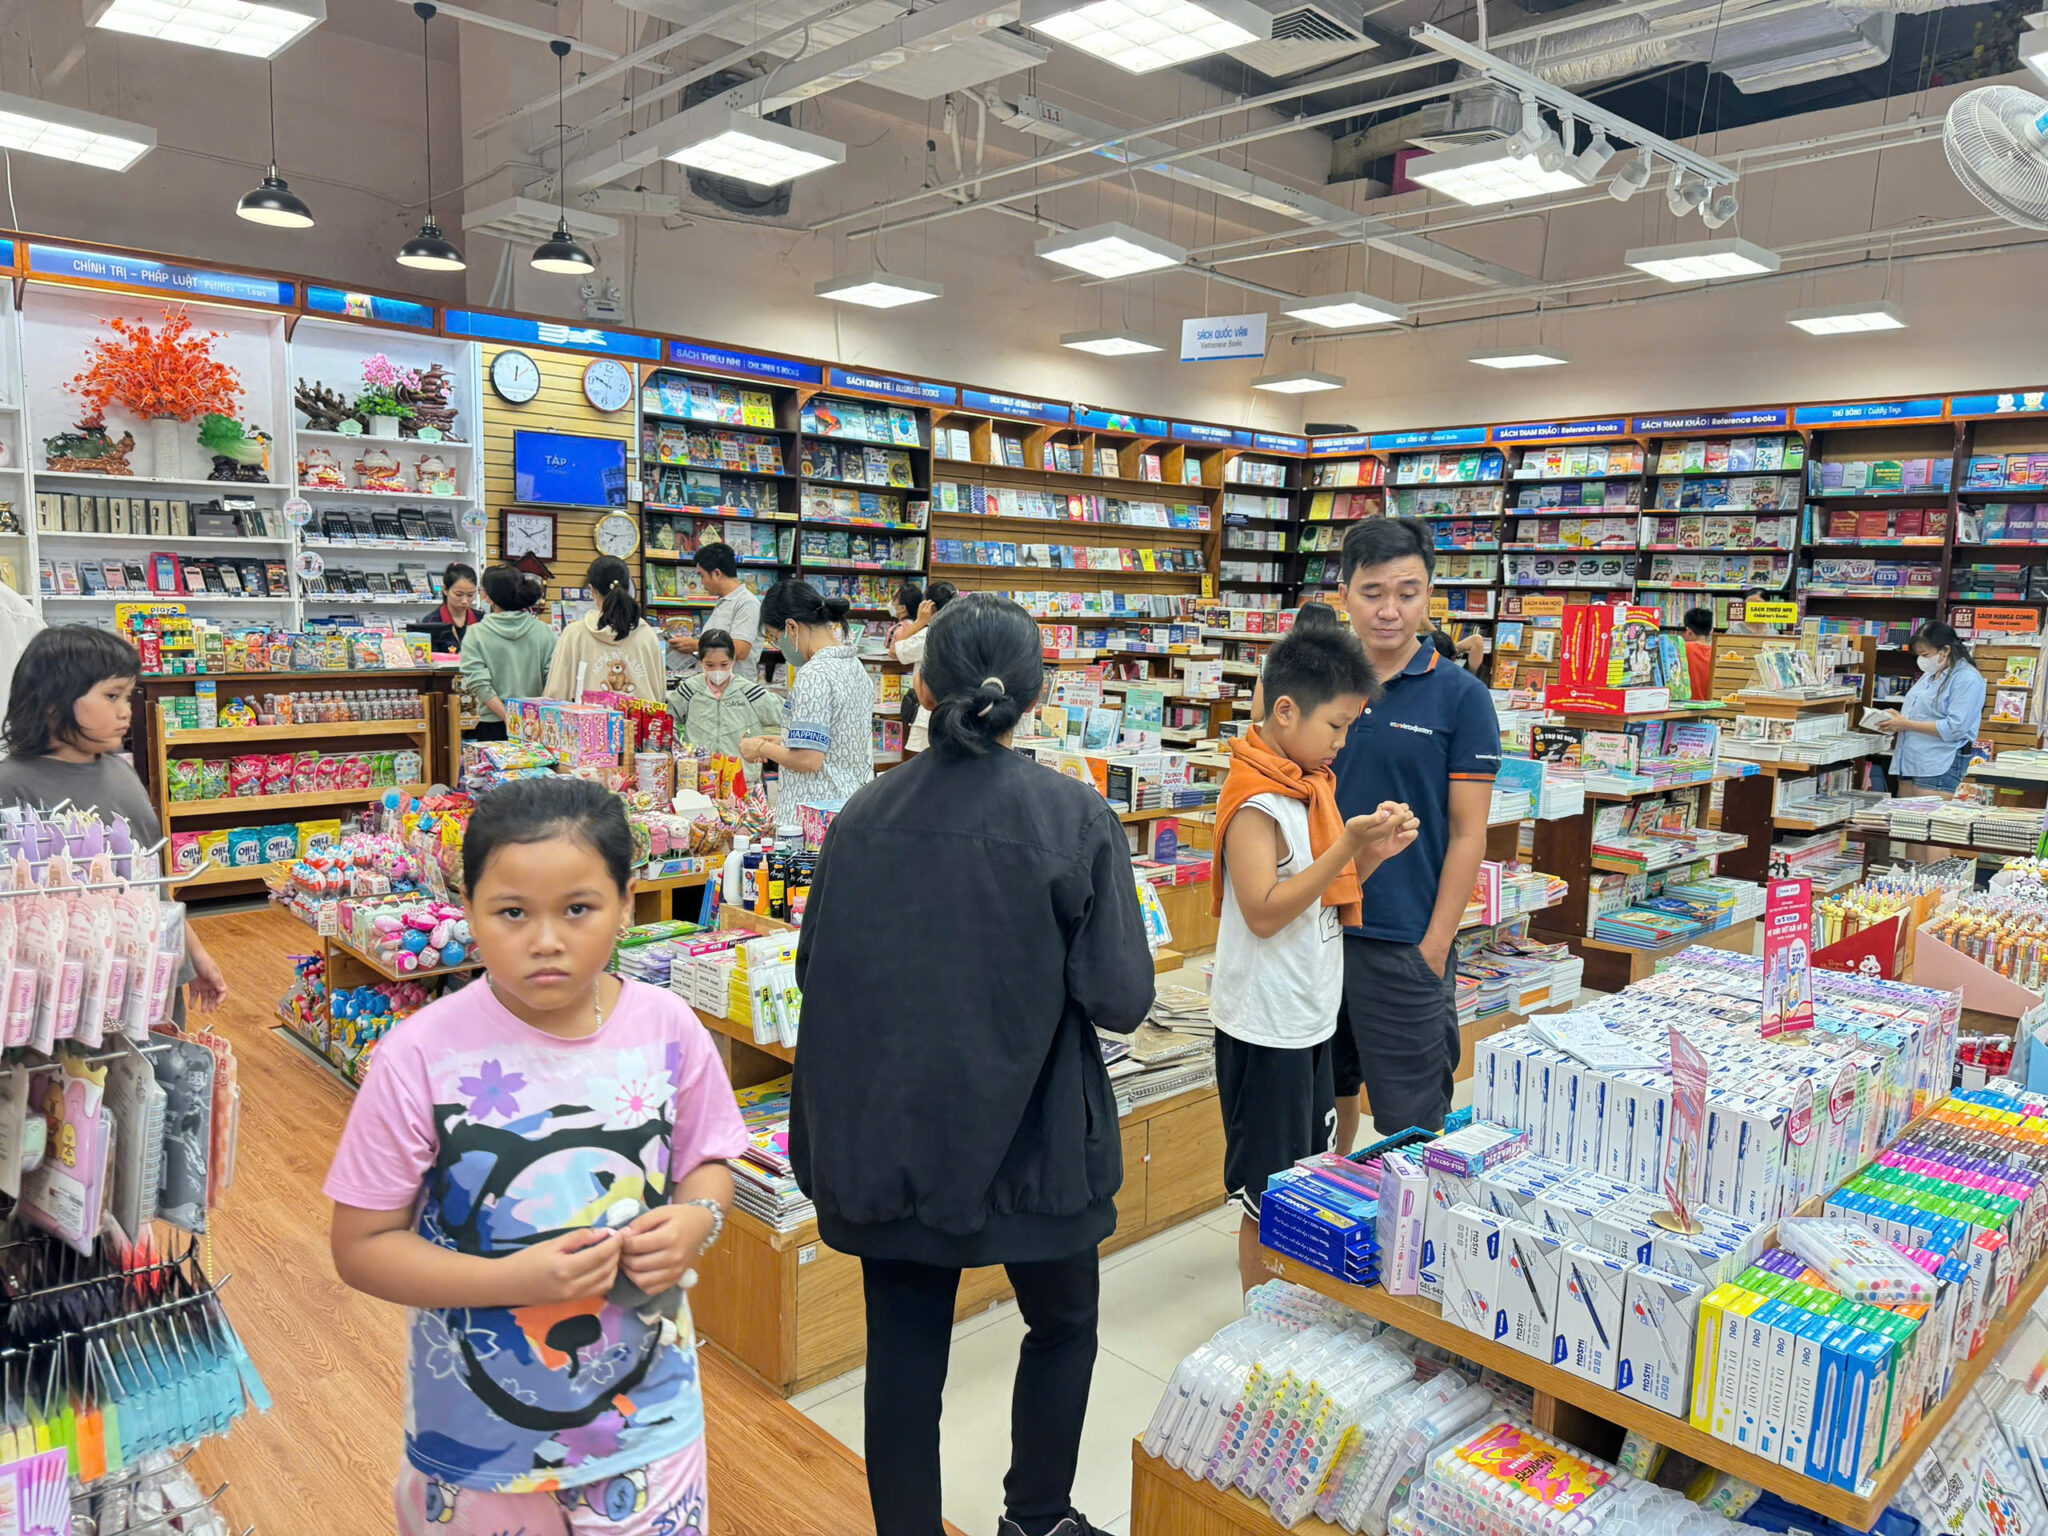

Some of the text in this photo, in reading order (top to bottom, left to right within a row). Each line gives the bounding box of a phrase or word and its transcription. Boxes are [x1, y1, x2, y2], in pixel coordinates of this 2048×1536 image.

[73, 258, 106, 274] CHÍNH
[110, 264, 127, 280] TRỊ
[141, 268, 169, 283] PHÁP
[172, 273, 199, 289] LUẬT
[1197, 326, 1248, 340] SÁCH QUỐC VĂN
[604, 364, 614, 373] 12
[726, 356, 741, 366] NHI
[588, 376, 625, 392] 9 3
[846, 375, 940, 398] SÁCH KINH TẾ BUSINESS BOOKS
[1868, 406, 1887, 415] Cuddly
[1641, 413, 1777, 429] SÁCH THAM KHẢO Reference Books
[1500, 423, 1617, 438] SÁCH THAM KHẢO Reference Books
[544, 454, 568, 469] TẬP
[1911, 573, 1932, 581] IELTS
[1730, 607, 1744, 615] BEST
[1955, 613, 1972, 622] BEST
[790, 729, 830, 745] HAPPINESS
[1728, 1320, 1737, 1340] deli
[1752, 1328, 1761, 1348] deli
[1776, 1337, 1785, 1357] deli
[1802, 1346, 1811, 1368] deli
[1724, 1350, 1737, 1401] DELIGHT
[1748, 1358, 1761, 1410] DELIGHT
[1772, 1367, 1785, 1419] DELIGHT
[1797, 1377, 1811, 1430] DELIGHT
